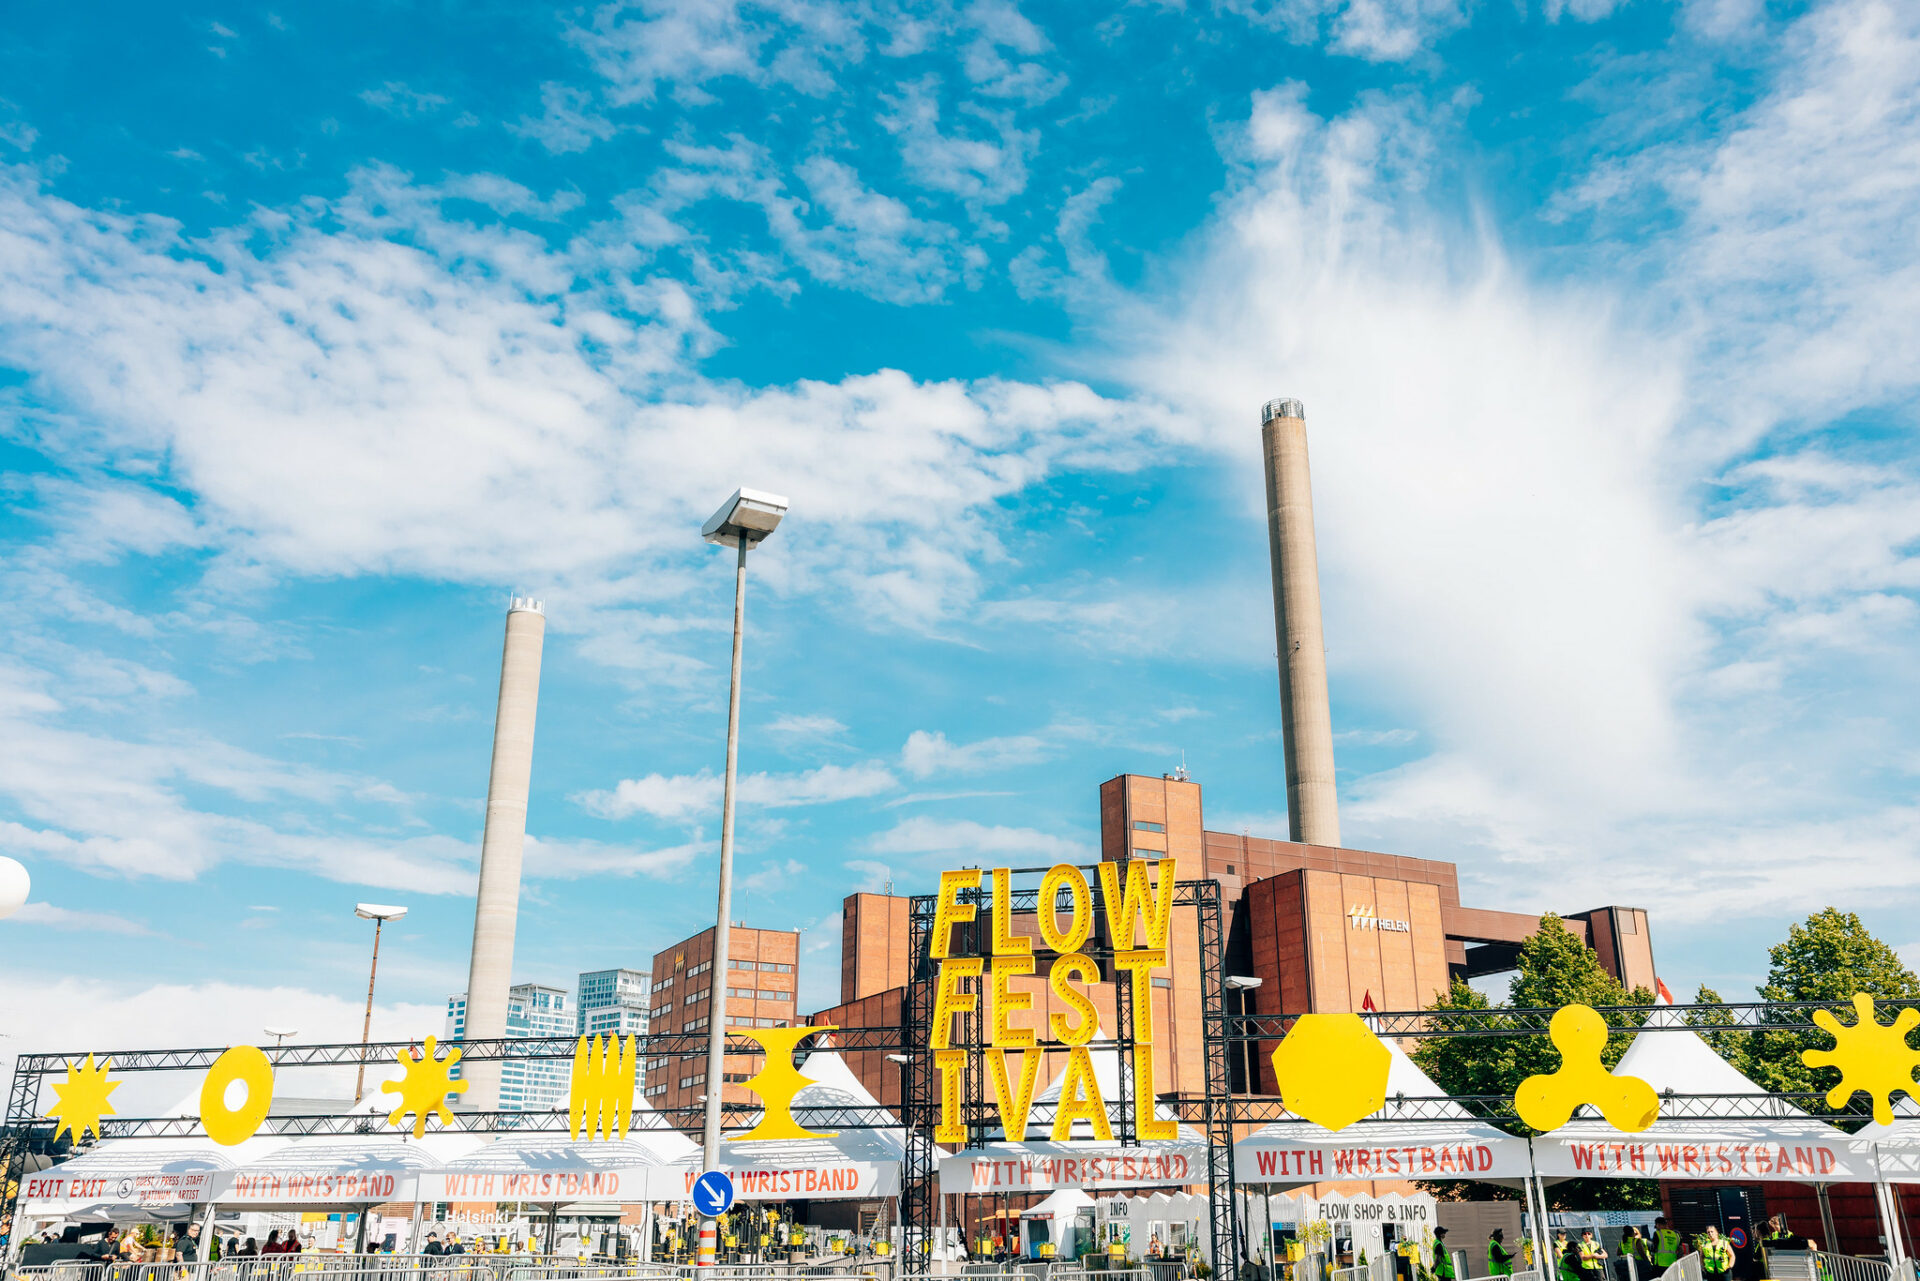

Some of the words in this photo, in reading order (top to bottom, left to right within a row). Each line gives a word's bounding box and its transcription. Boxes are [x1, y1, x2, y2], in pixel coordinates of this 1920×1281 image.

[930, 858, 1177, 958] FLOW
[1379, 918, 1409, 932] HELEN
[930, 950, 1168, 1049] FEST
[935, 1042, 1178, 1143] IVAL
[971, 1160, 1032, 1186] WITH
[1042, 1154, 1188, 1183] WRISTBAND
[1256, 1150, 1324, 1176] WITH
[1333, 1146, 1493, 1174] WRISTBAND
[1571, 1144, 1645, 1171] WITH
[1655, 1145, 1835, 1174] WRISTBAND
[27, 1179, 64, 1198] EXIT
[69, 1179, 107, 1198] EXIT
[136, 1176, 155, 1187] GUEST
[161, 1175, 180, 1186] PRESS
[185, 1175, 205, 1186] STAFF
[236, 1175, 282, 1198] WITH
[288, 1174, 395, 1197] WRISTBAND
[445, 1174, 494, 1196] WITH
[502, 1172, 620, 1196] WRISTBAND
[741, 1168, 859, 1193] WRISTBAND
[139, 1190, 171, 1200] PLATINUM
[177, 1189, 200, 1200] ARTIST
[445, 1209, 509, 1224] Helsinki
[1110, 1202, 1128, 1217] INFO
[1319, 1203, 1350, 1220] FLOW
[1354, 1203, 1384, 1220] SHOP
[1387, 1204, 1396, 1220] &
[1400, 1204, 1427, 1221] INFO
